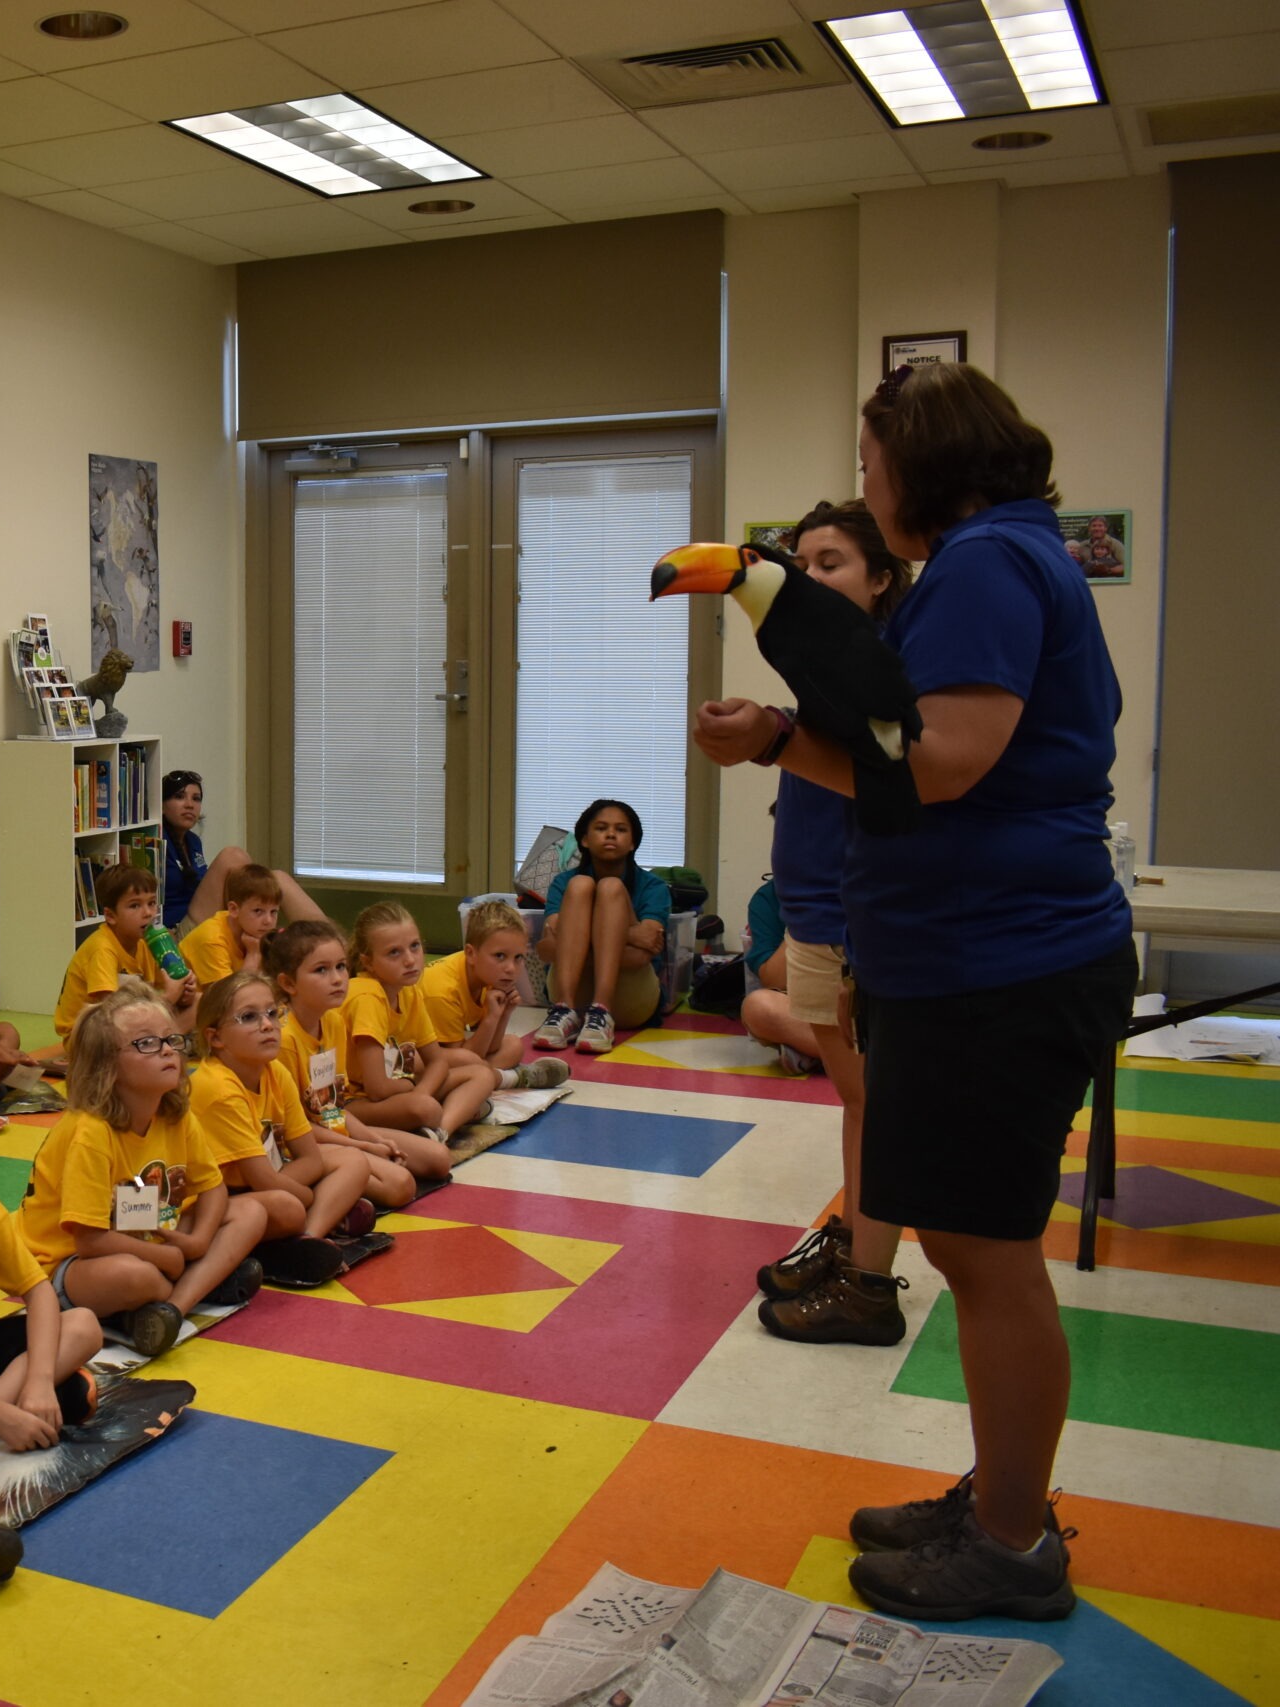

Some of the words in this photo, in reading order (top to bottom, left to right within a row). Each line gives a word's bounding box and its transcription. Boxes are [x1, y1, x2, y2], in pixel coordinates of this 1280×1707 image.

[906, 355, 941, 364] NOTICE
[121, 1201, 152, 1214] Summer
[160, 1209, 173, 1218] OO
